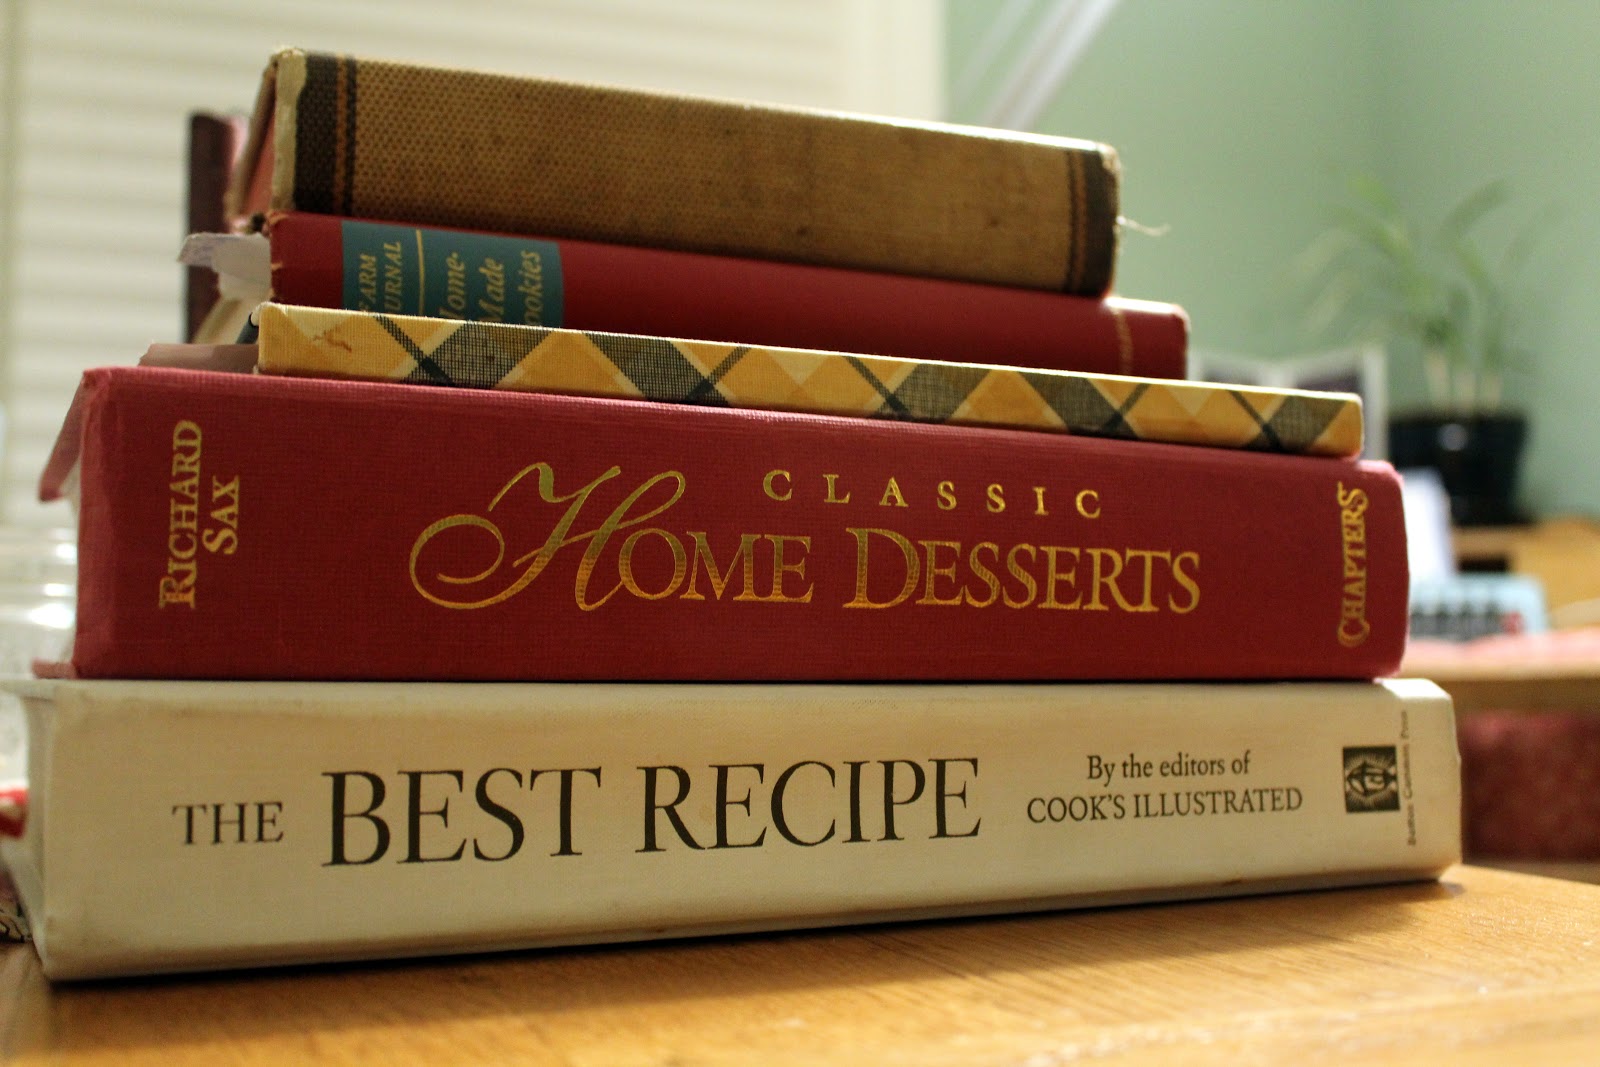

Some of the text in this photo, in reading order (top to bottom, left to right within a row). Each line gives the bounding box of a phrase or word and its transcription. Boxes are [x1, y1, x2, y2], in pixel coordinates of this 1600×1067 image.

[383, 241, 402, 313] URNAL
[518, 250, 544, 326] ookies
[158, 419, 202, 609] RICHARD
[202, 474, 240, 555] SAX
[762, 469, 1101, 519] CLASSIC
[842, 527, 1201, 614] DESSERTS
[1336, 480, 1371, 648] CHAPTERS
[1026, 786, 1304, 824] COOK'S ILLUSTRATED
[1086, 748, 1251, 787] By the editors of
[171, 757, 982, 867] THE BEST RECIPE
